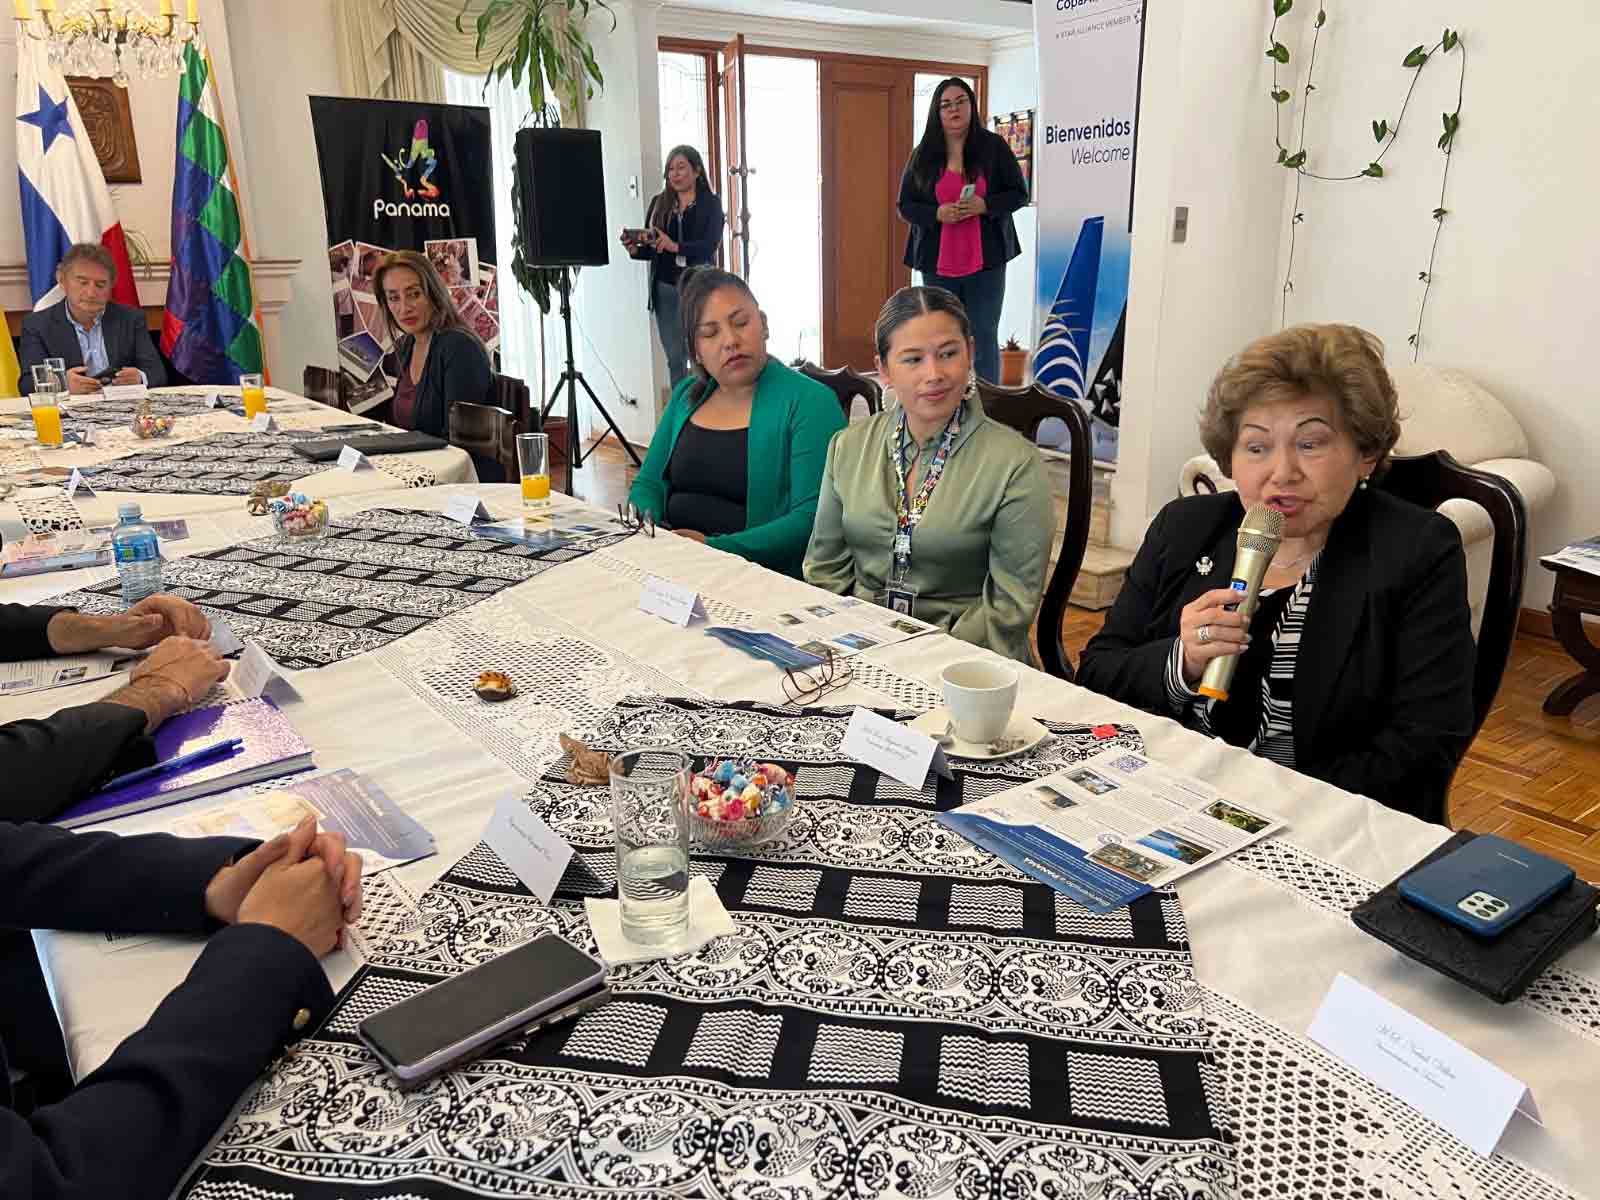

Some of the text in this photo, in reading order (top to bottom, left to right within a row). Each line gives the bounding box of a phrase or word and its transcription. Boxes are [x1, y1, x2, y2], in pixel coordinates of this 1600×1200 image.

[1046, 117, 1131, 145] Bienvenidos
[1071, 145, 1130, 165] Welcome
[373, 199, 450, 219] Panama
